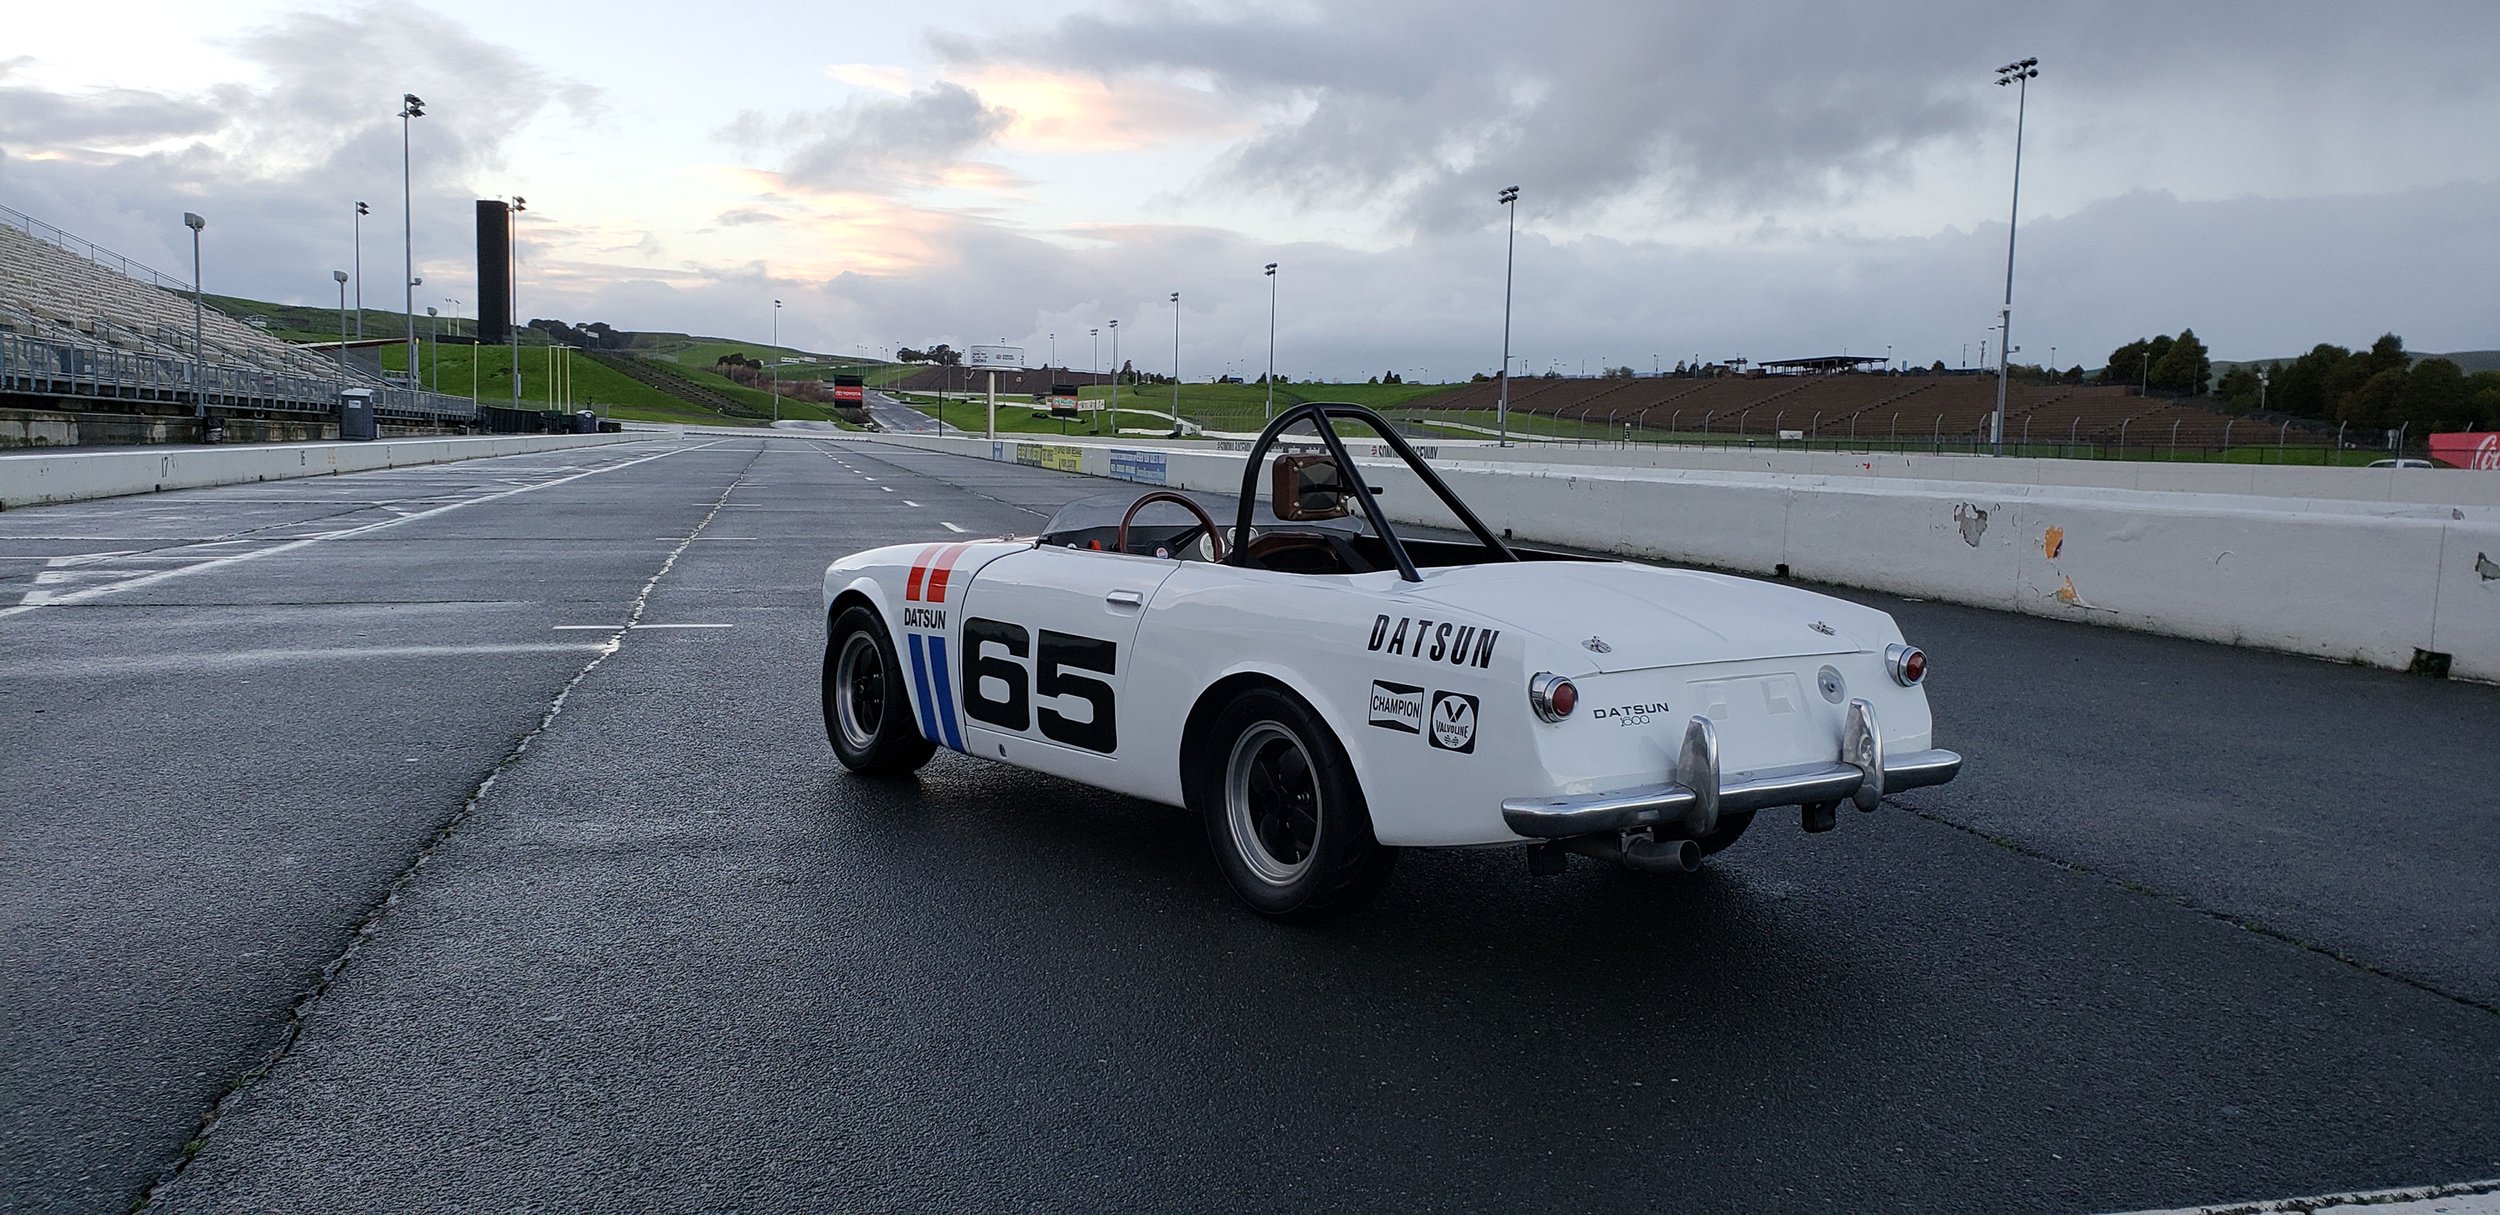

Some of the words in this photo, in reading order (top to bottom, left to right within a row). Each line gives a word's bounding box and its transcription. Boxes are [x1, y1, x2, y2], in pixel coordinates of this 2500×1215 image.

[1411, 445, 1439, 460] ACEWAY
[904, 607, 947, 630] DATSUN
[1367, 614, 1500, 669] DATSUN
[962, 616, 1118, 754] 65
[1372, 695, 1420, 719] CHAMPION
[1593, 702, 1669, 719] DATSUN
[1435, 719, 1469, 738] VALVOLINE
